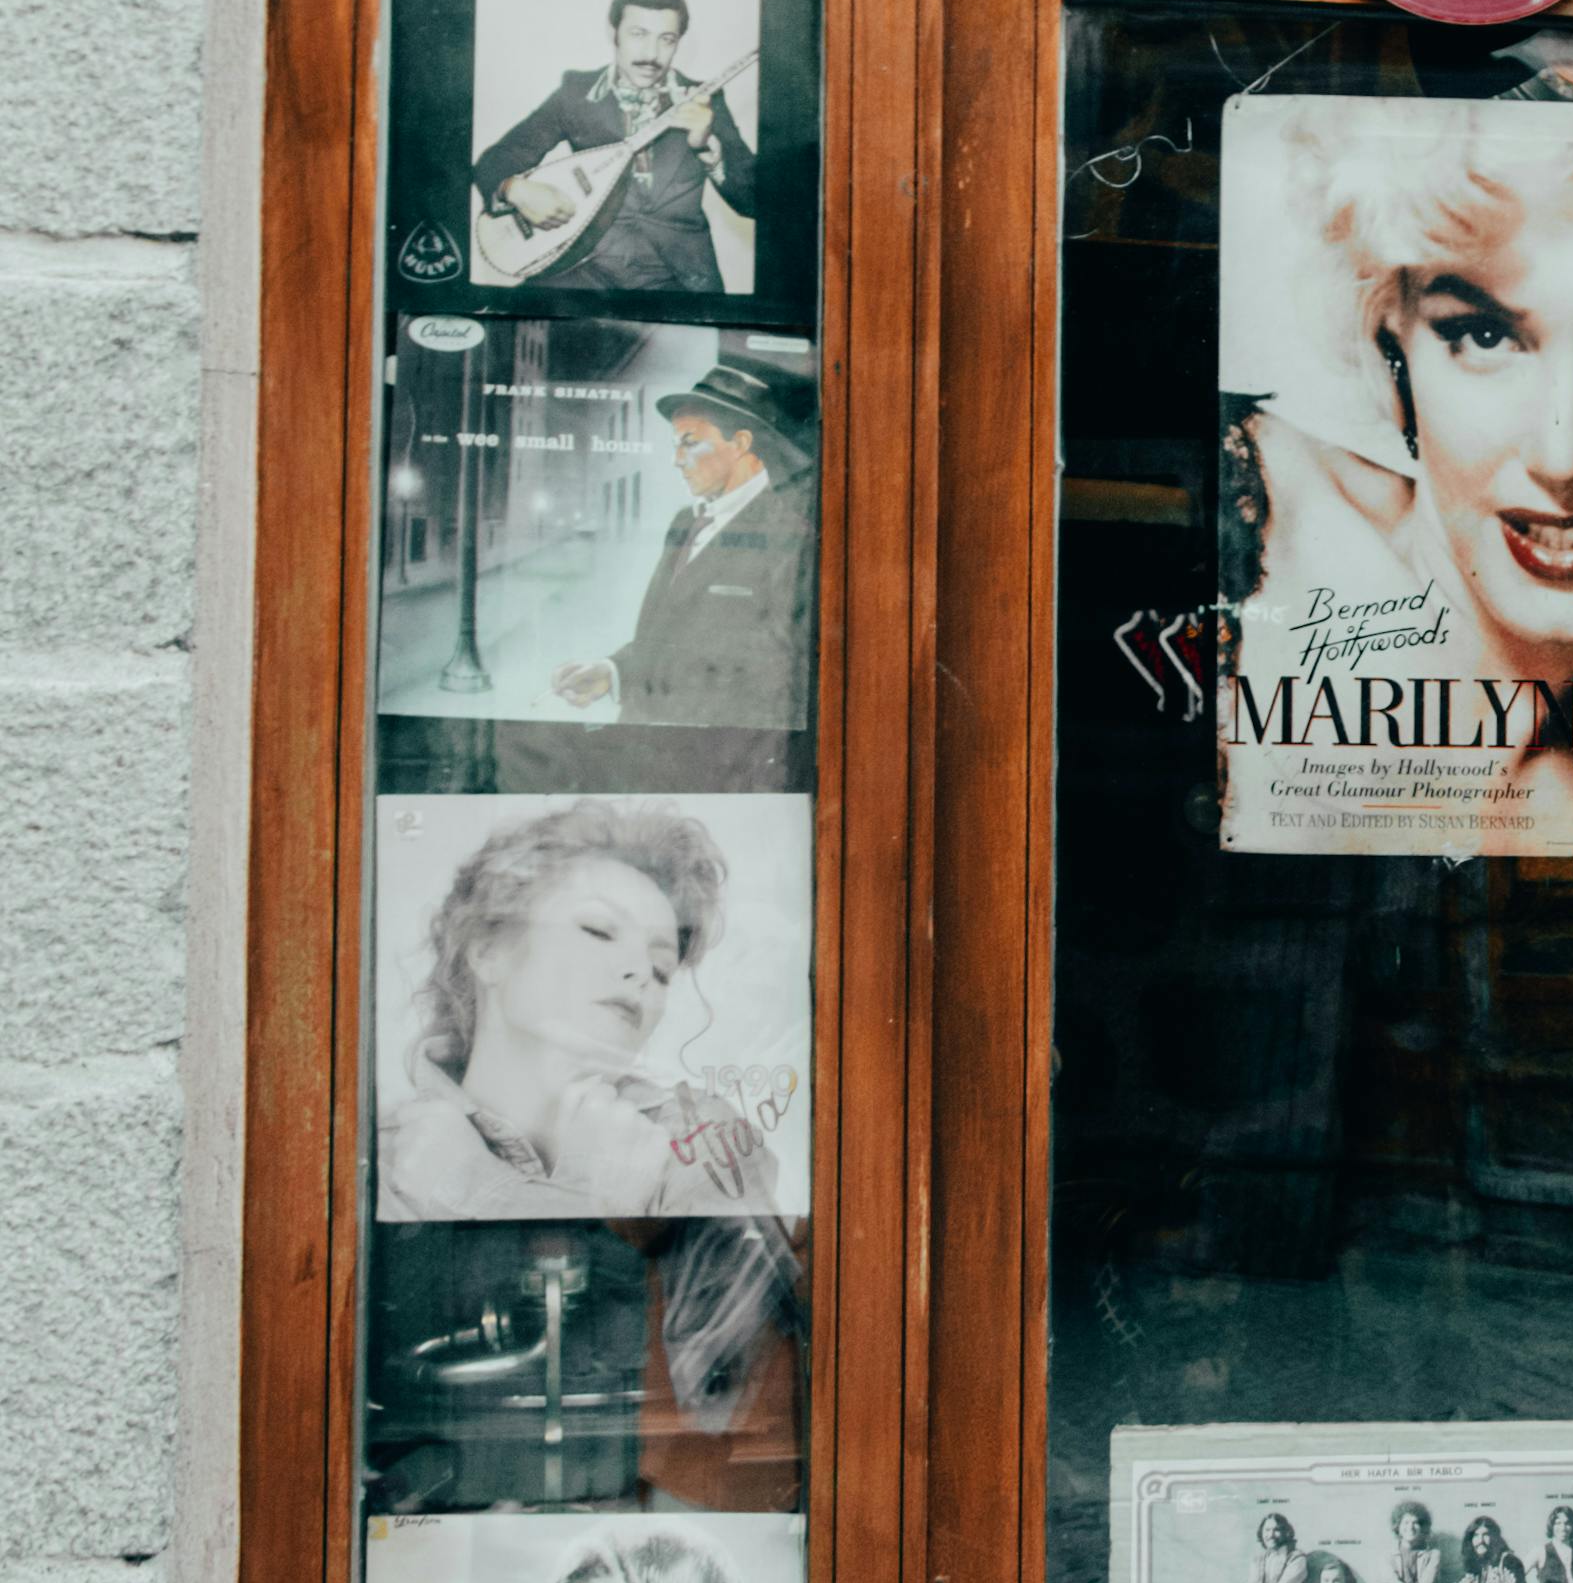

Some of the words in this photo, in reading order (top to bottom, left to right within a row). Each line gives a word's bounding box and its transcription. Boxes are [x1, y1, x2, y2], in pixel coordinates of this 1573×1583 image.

[481, 383, 547, 397] FRANK
[553, 386, 635, 401] SINATRA
[456, 432, 500, 448] wee
[514, 432, 575, 451] small
[590, 434, 654, 454] hours
[1290, 578, 1435, 631] Bernard
[1300, 757, 1364, 777] Images
[1370, 757, 1391, 778] by
[1270, 780, 1321, 797] Great
[1327, 780, 1406, 799] Glamour
[1411, 782, 1536, 803] Photographer
[1270, 811, 1304, 827] TEXT
[1308, 812, 1338, 828] AND
[1341, 812, 1394, 829] EDITED
[1398, 813, 1416, 829] BY
[1418, 813, 1465, 830] SUSAN
[1469, 813, 1536, 831] BERNARD
[701, 1064, 799, 1098] 1990
[1367, 1467, 1400, 1478] HAFTA
[1429, 1465, 1463, 1476] TABLO
